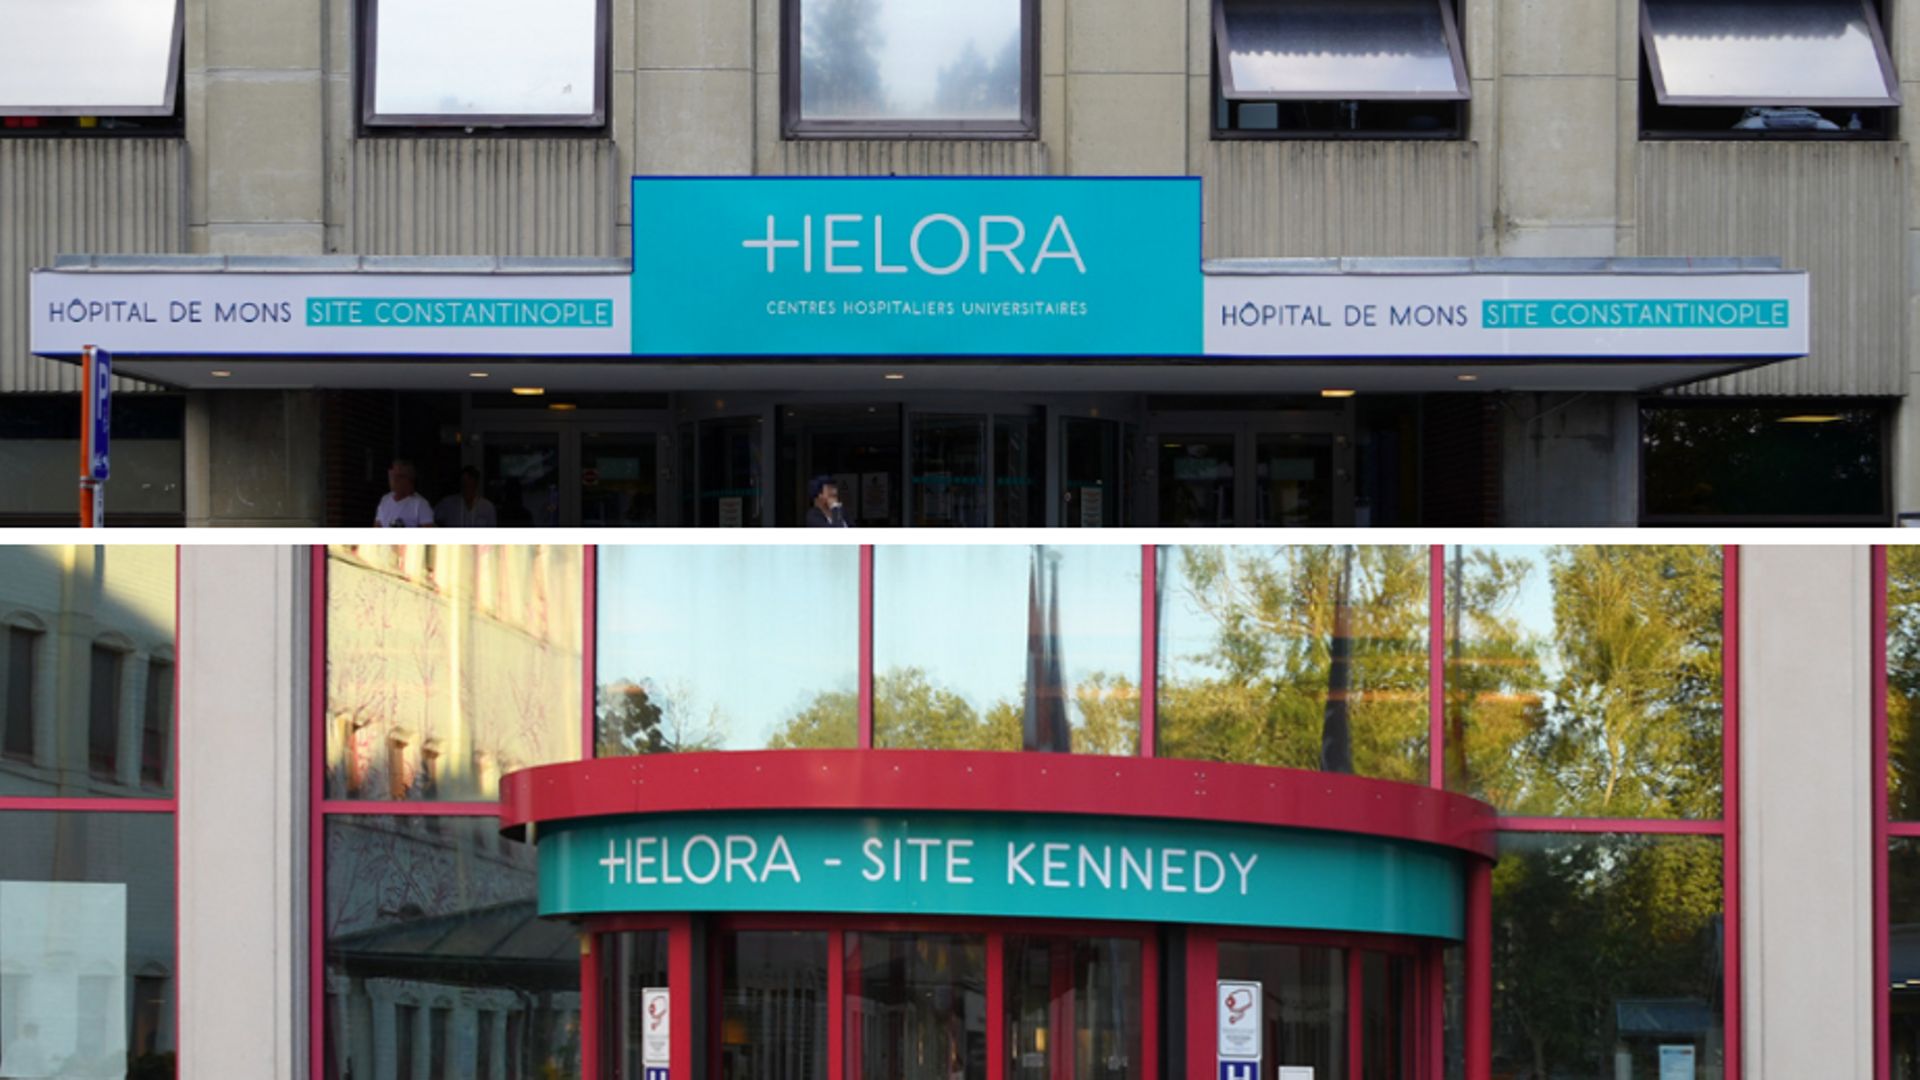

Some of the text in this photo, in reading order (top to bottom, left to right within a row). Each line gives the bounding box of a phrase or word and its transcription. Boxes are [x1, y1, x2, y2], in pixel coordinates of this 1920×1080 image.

[742, 213, 1087, 276] HELORA
[49, 297, 610, 326] HÔPITAL DE MONS SITE CONSTANTINOPLE
[766, 299, 1088, 318] CENTRES HOSPITALIERS UNIVERSITAIRES
[1221, 300, 1786, 328] HÔPITAL DE MONS SITE CONSTANTINOPLE
[98, 362, 109, 421] P
[599, 834, 801, 885] HELORA
[861, 837, 974, 884] SITE
[1006, 841, 1259, 896] KENNEDY
